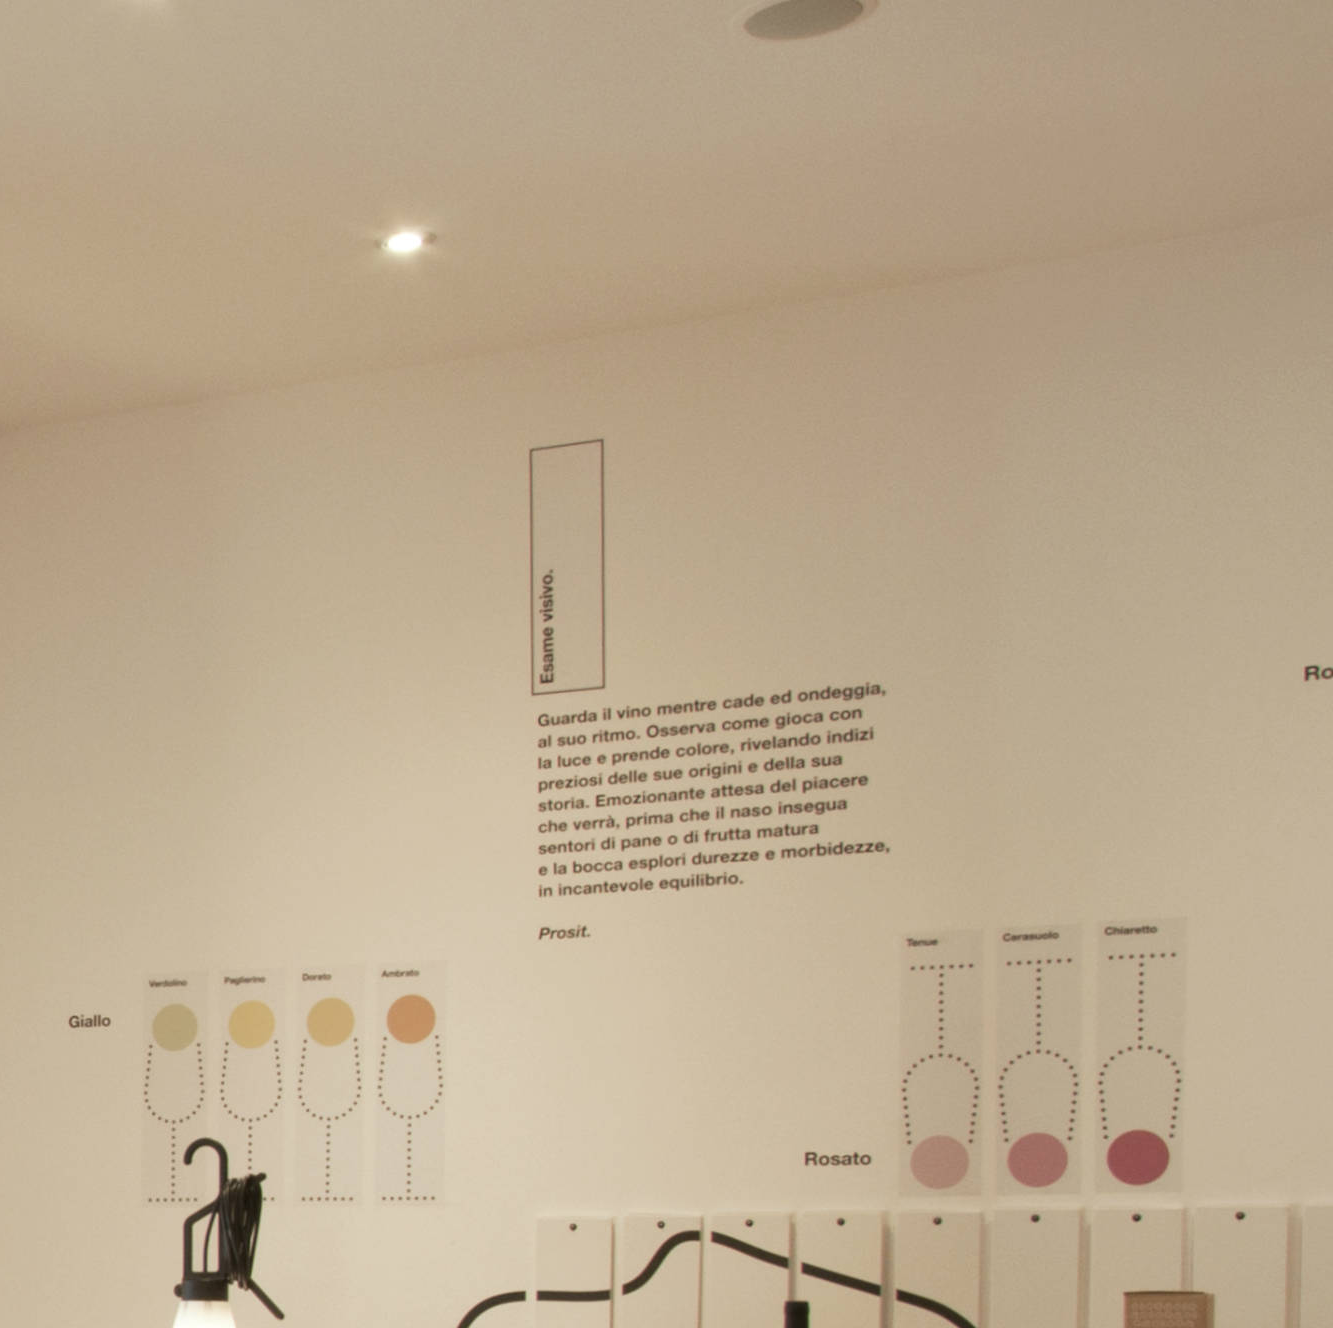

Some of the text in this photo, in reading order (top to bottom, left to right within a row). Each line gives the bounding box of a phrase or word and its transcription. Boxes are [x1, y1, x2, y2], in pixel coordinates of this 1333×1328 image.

[539, 569, 554, 684] Esame visivo.
[537, 681, 887, 728] Guarda il vino mentre cade ed ondeggia,
[538, 708, 864, 748] al suo ritmo. Osserva come gioca con
[538, 726, 875, 769] la luce e prende colore, rivelando indizi
[537, 754, 844, 795] preziosi delle sue origini e della sua
[537, 774, 870, 813] storia. Emozionante attesa del piacere
[537, 798, 849, 834] che verrà, prima che il naso insegua
[537, 823, 820, 856] sentori di pane o di frutta matura
[538, 840, 891, 877] e la bocca esplori durezze e morbidezze,
[538, 871, 745, 898] in incantevole equilibrio.
[537, 924, 592, 941] Prosit.
[68, 1014, 112, 1029] Giallo
[804, 1151, 872, 1166] Rosato
